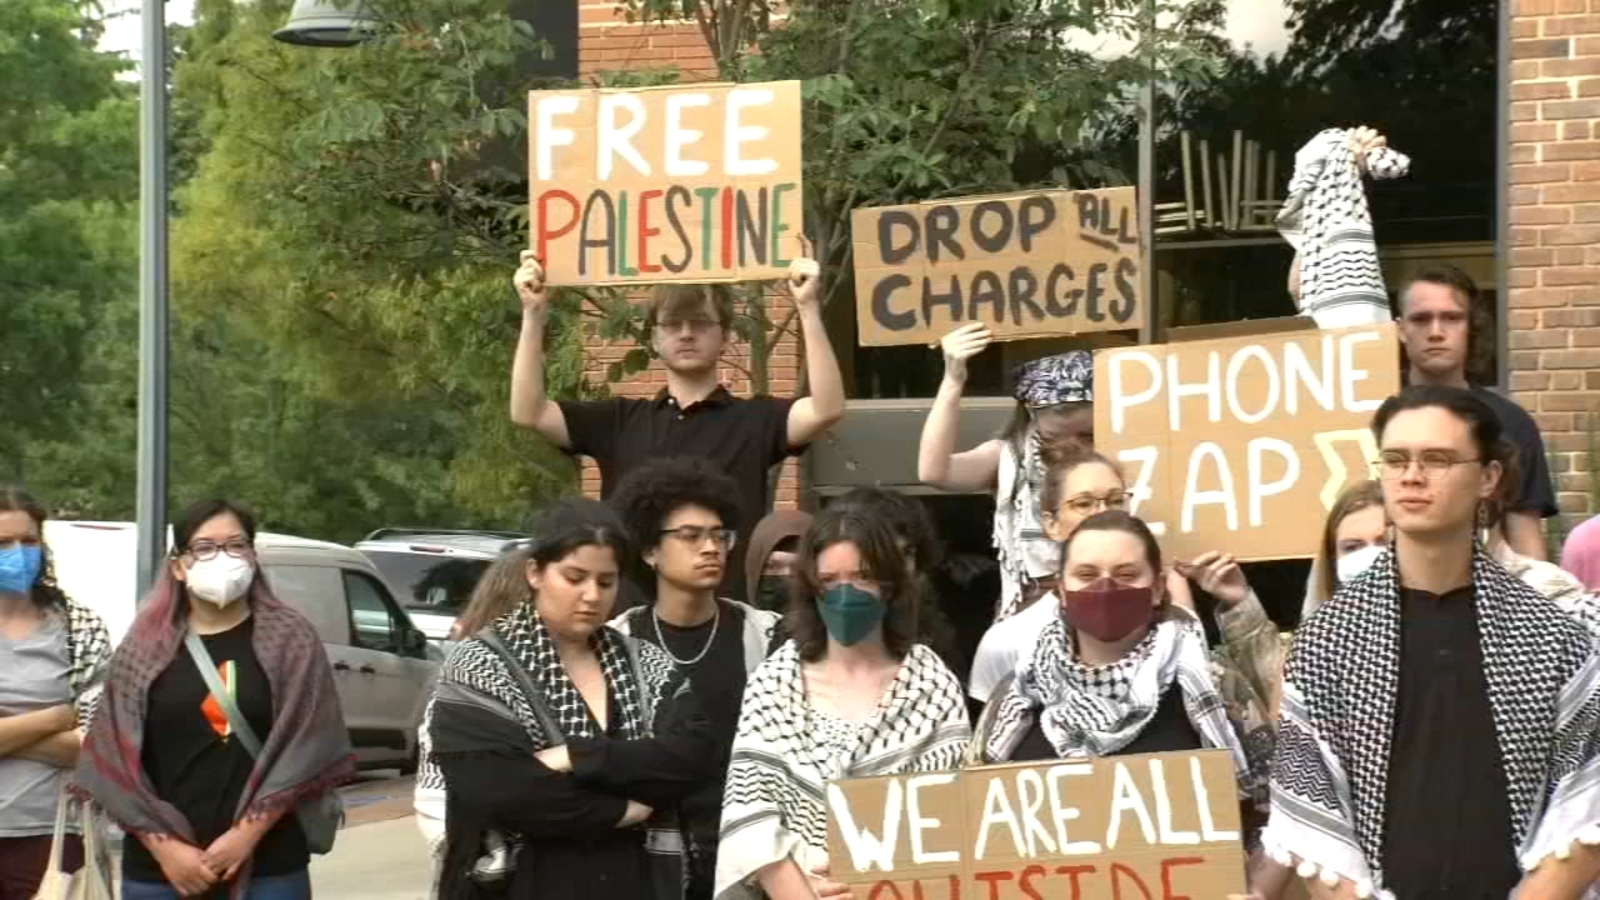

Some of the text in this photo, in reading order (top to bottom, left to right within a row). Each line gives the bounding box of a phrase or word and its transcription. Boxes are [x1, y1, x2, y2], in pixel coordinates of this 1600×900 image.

[535, 88, 780, 180] FREE
[536, 183, 796, 277] PALESTINE
[878, 193, 1138, 266] DROP ALL
[871, 257, 1136, 331] CHARGES
[1108, 331, 1388, 434] PHONE
[1117, 437, 1300, 535] ZAP
[827, 757, 1240, 872] WE ARE ALL
